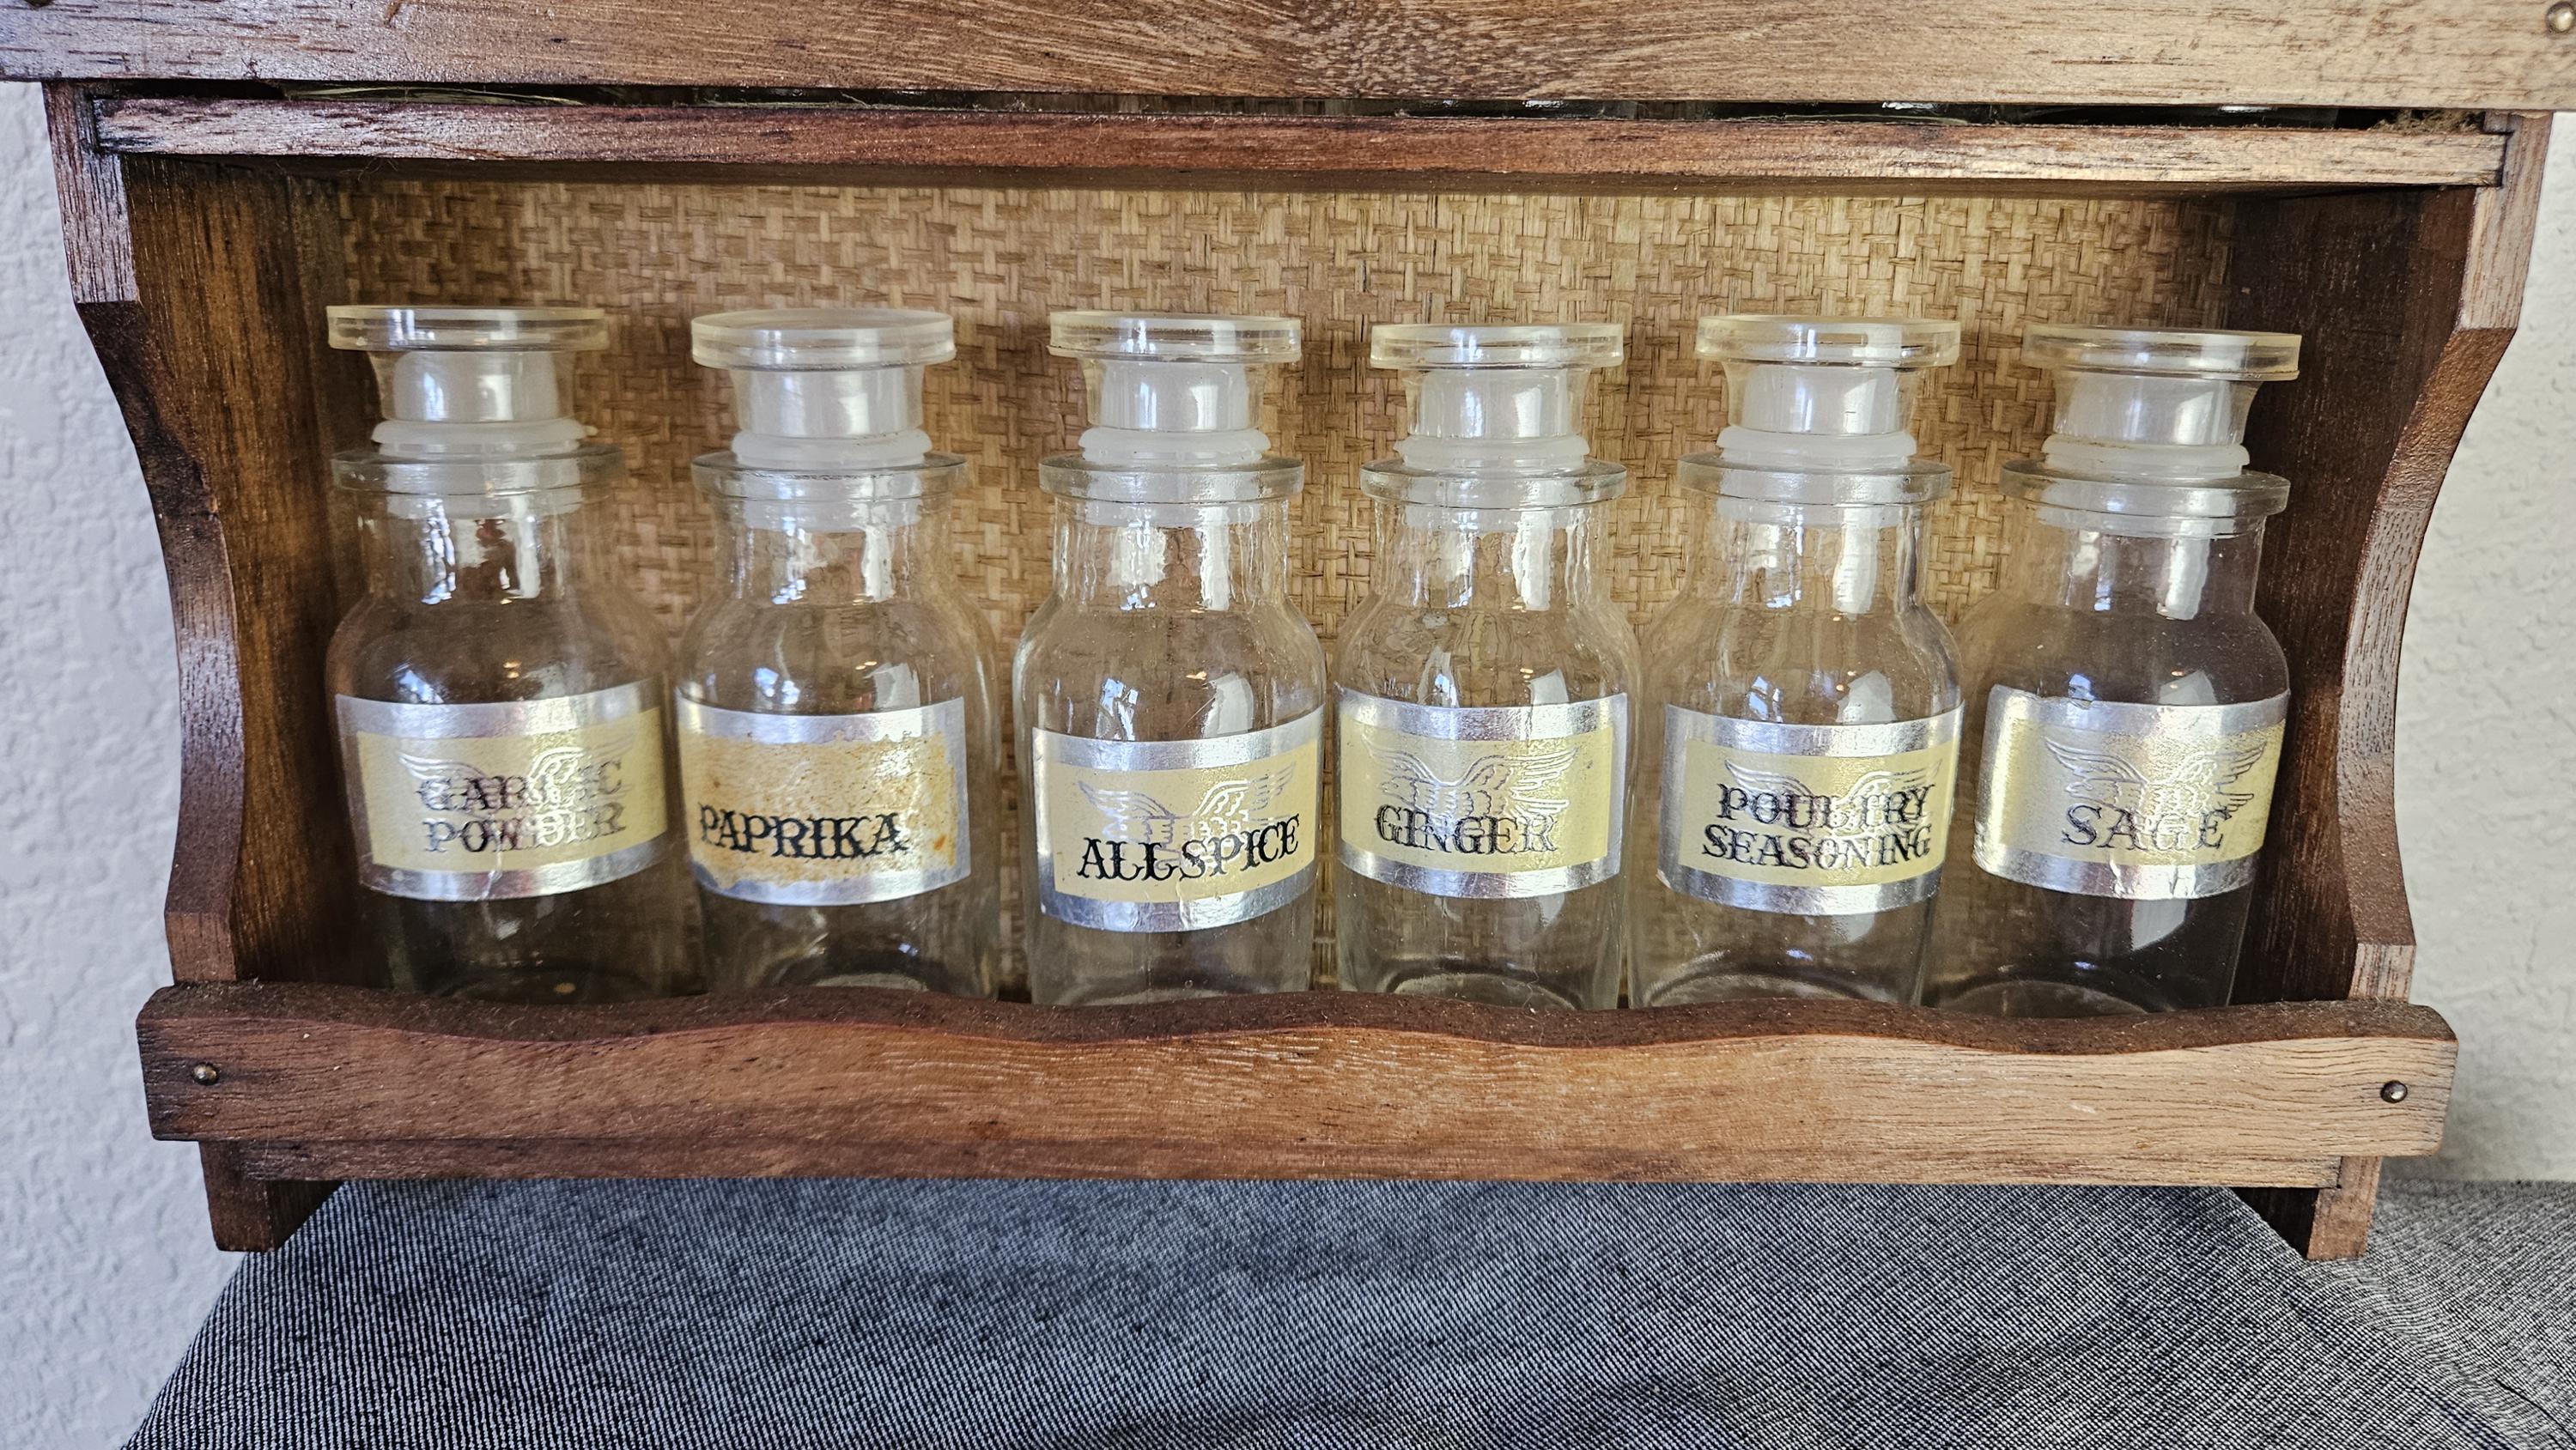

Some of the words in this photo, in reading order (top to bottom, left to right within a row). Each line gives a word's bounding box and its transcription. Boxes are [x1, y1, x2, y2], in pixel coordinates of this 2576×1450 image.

[1375, 804, 1558, 855] GINGER
[1716, 783, 1935, 828] POULTRY
[2061, 804, 2232, 851] SAGE
[698, 804, 909, 859] PAPRIKA
[1077, 813, 1300, 882] ALLSPICE
[1704, 823, 1932, 871] SEASONING
